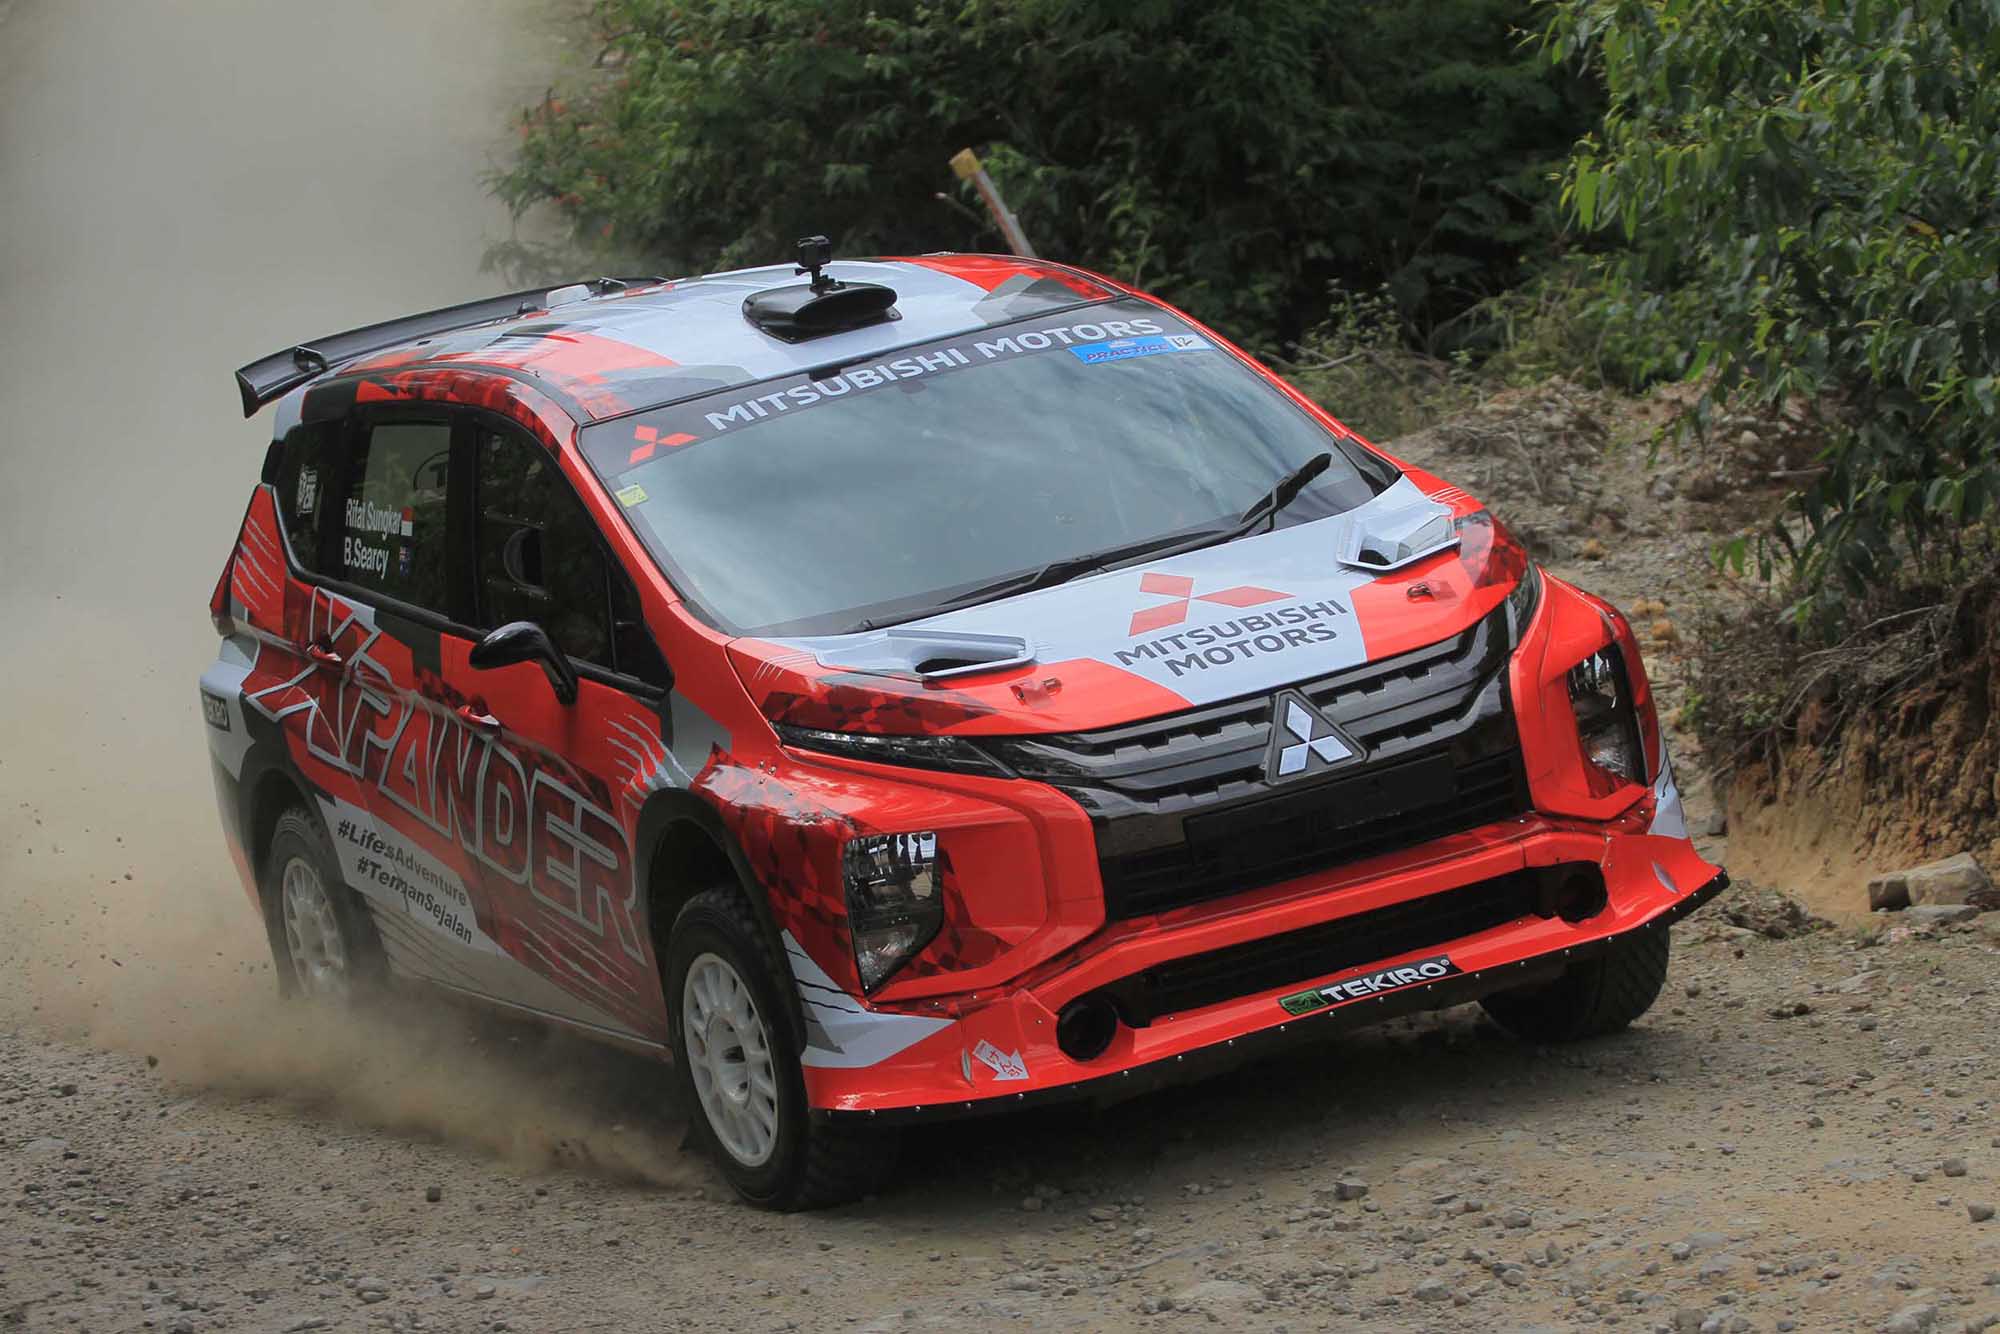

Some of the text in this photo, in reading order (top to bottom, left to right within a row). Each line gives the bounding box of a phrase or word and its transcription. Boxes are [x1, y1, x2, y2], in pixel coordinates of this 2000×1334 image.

[706, 318, 1164, 431] MITSUBISHI MOTORS
[344, 536, 389, 580] B.Searcy
[367, 501, 402, 541] Sungkar
[1113, 599, 1348, 666] MITSUBISHI
[1164, 622, 1337, 677] MOTORS
[246, 585, 649, 966] XPANDER
[337, 818, 468, 907] #LifesAdventure
[356, 855, 473, 945] #TemanSejalan
